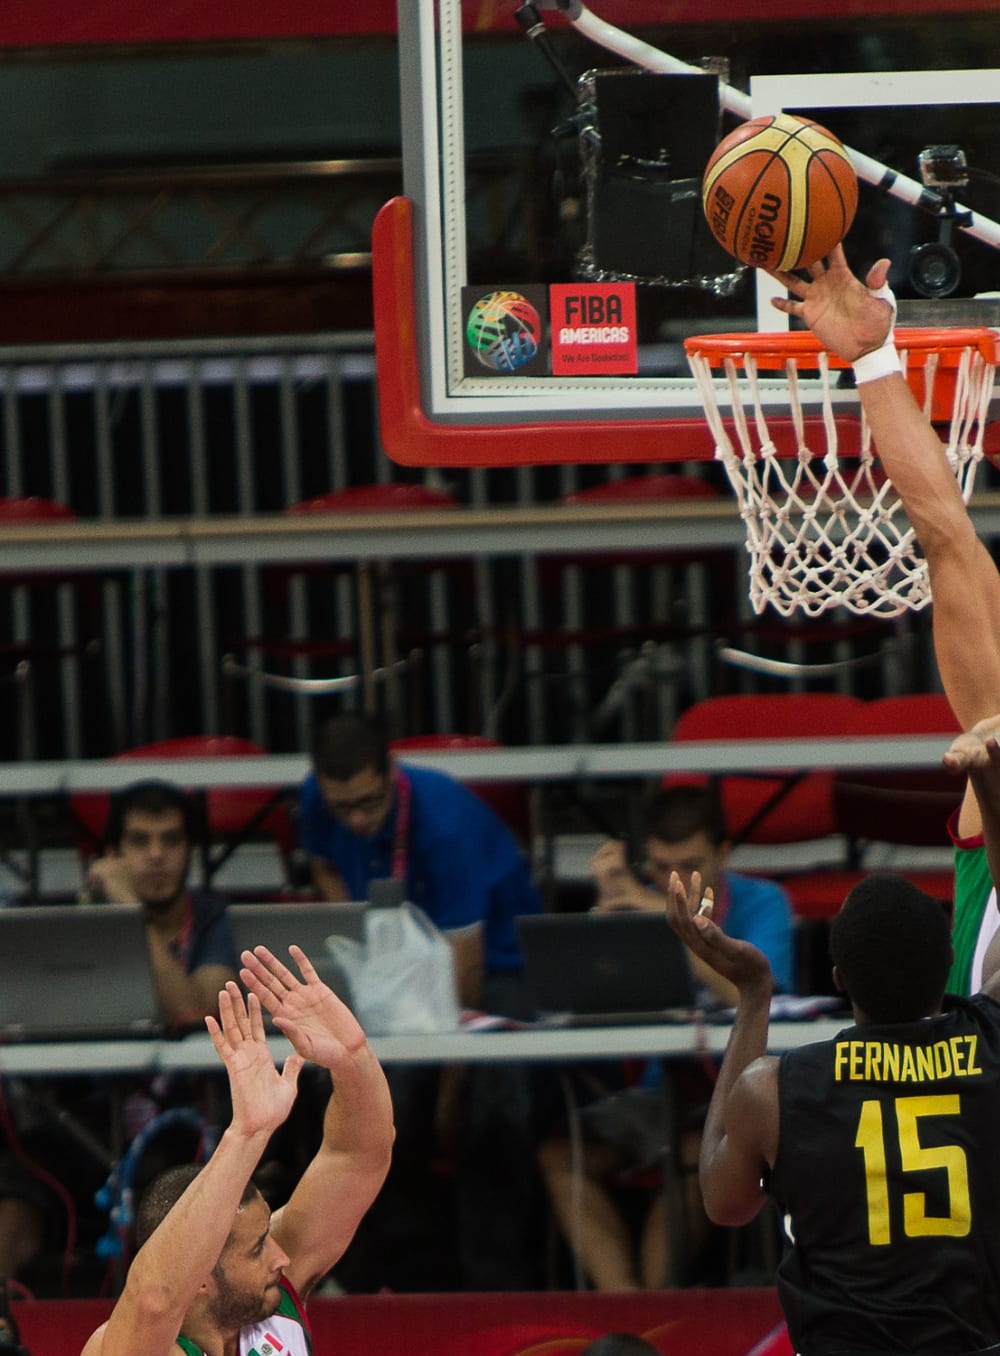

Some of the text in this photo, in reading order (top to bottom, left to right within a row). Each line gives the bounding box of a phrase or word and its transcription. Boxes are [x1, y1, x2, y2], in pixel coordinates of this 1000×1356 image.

[564, 295, 623, 325] FIBA
[559, 327, 629, 345] AMERICAS
[835, 1034, 983, 1082] FERNANDEZ
[855, 1093, 972, 1246] 15
